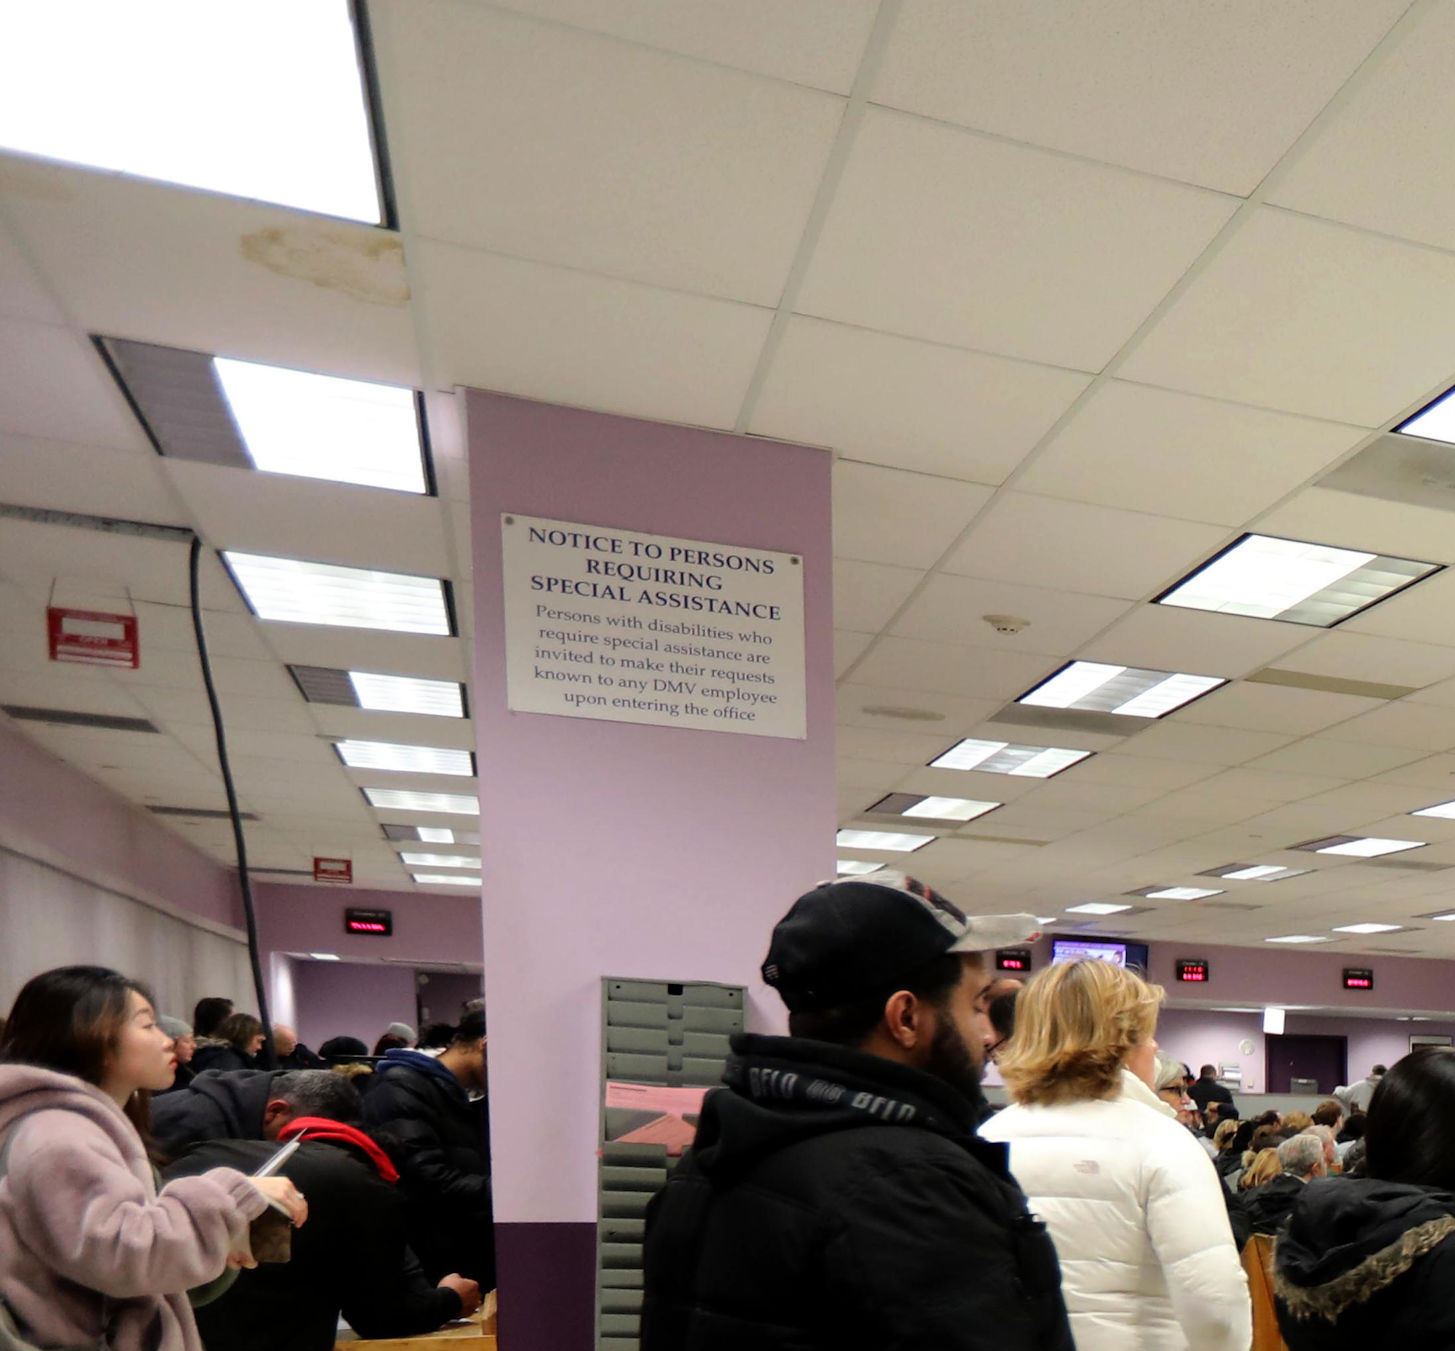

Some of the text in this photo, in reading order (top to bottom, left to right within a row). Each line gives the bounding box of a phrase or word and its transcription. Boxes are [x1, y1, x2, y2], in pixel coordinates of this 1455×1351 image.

[529, 527, 774, 574] NOTICE TO PERSONS
[586, 559, 722, 590] REQUIRING
[531, 575, 781, 620] SPECIAL ASSISTANCE
[536, 604, 773, 645] Persons with disabilities who
[540, 628, 770, 664] require special assistance are
[536, 646, 775, 685] invited to make their requests
[535, 666, 777, 704] known to any DMV employee
[565, 691, 755, 720] upon entering the office
